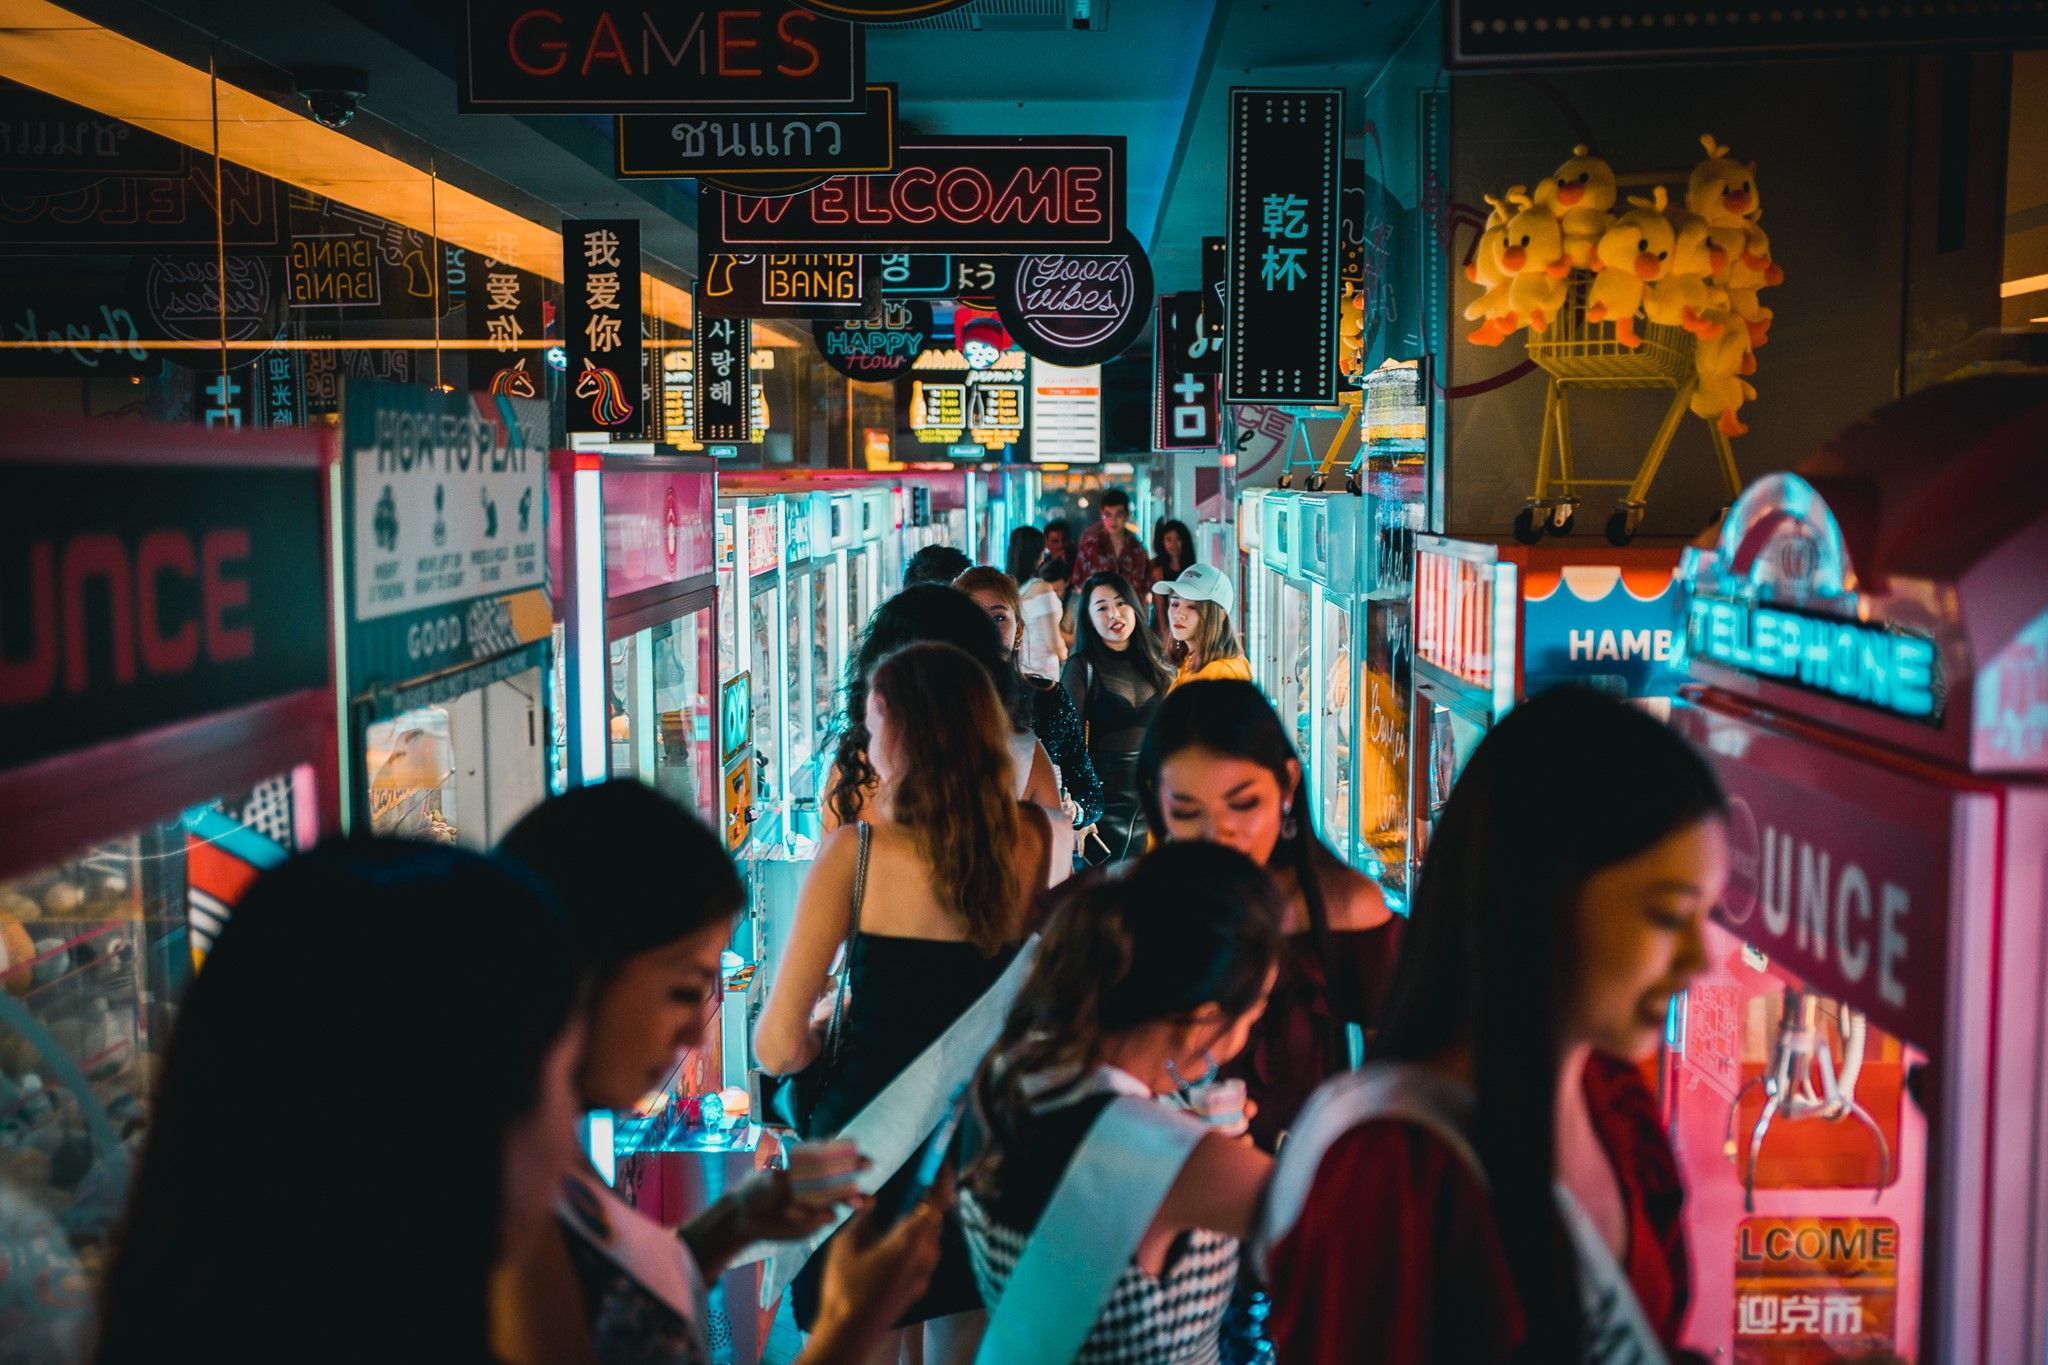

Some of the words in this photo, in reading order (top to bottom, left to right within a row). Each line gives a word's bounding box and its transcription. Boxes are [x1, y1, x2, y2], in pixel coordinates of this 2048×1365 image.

[508, 10, 820, 77] GAMES
[1261, 193, 1309, 292] 乾杯
[583, 229, 622, 353] 我爱你
[769, 271, 855, 299] BANG
[1032, 254, 1129, 288] Good
[1027, 281, 1116, 311] vibes
[708, 319, 736, 406] 사랑해
[826, 332, 924, 355] HAPPY
[845, 344, 907, 370] Hour
[407, 614, 462, 661] GOOD
[1693, 597, 1935, 716] TELEPHONE
